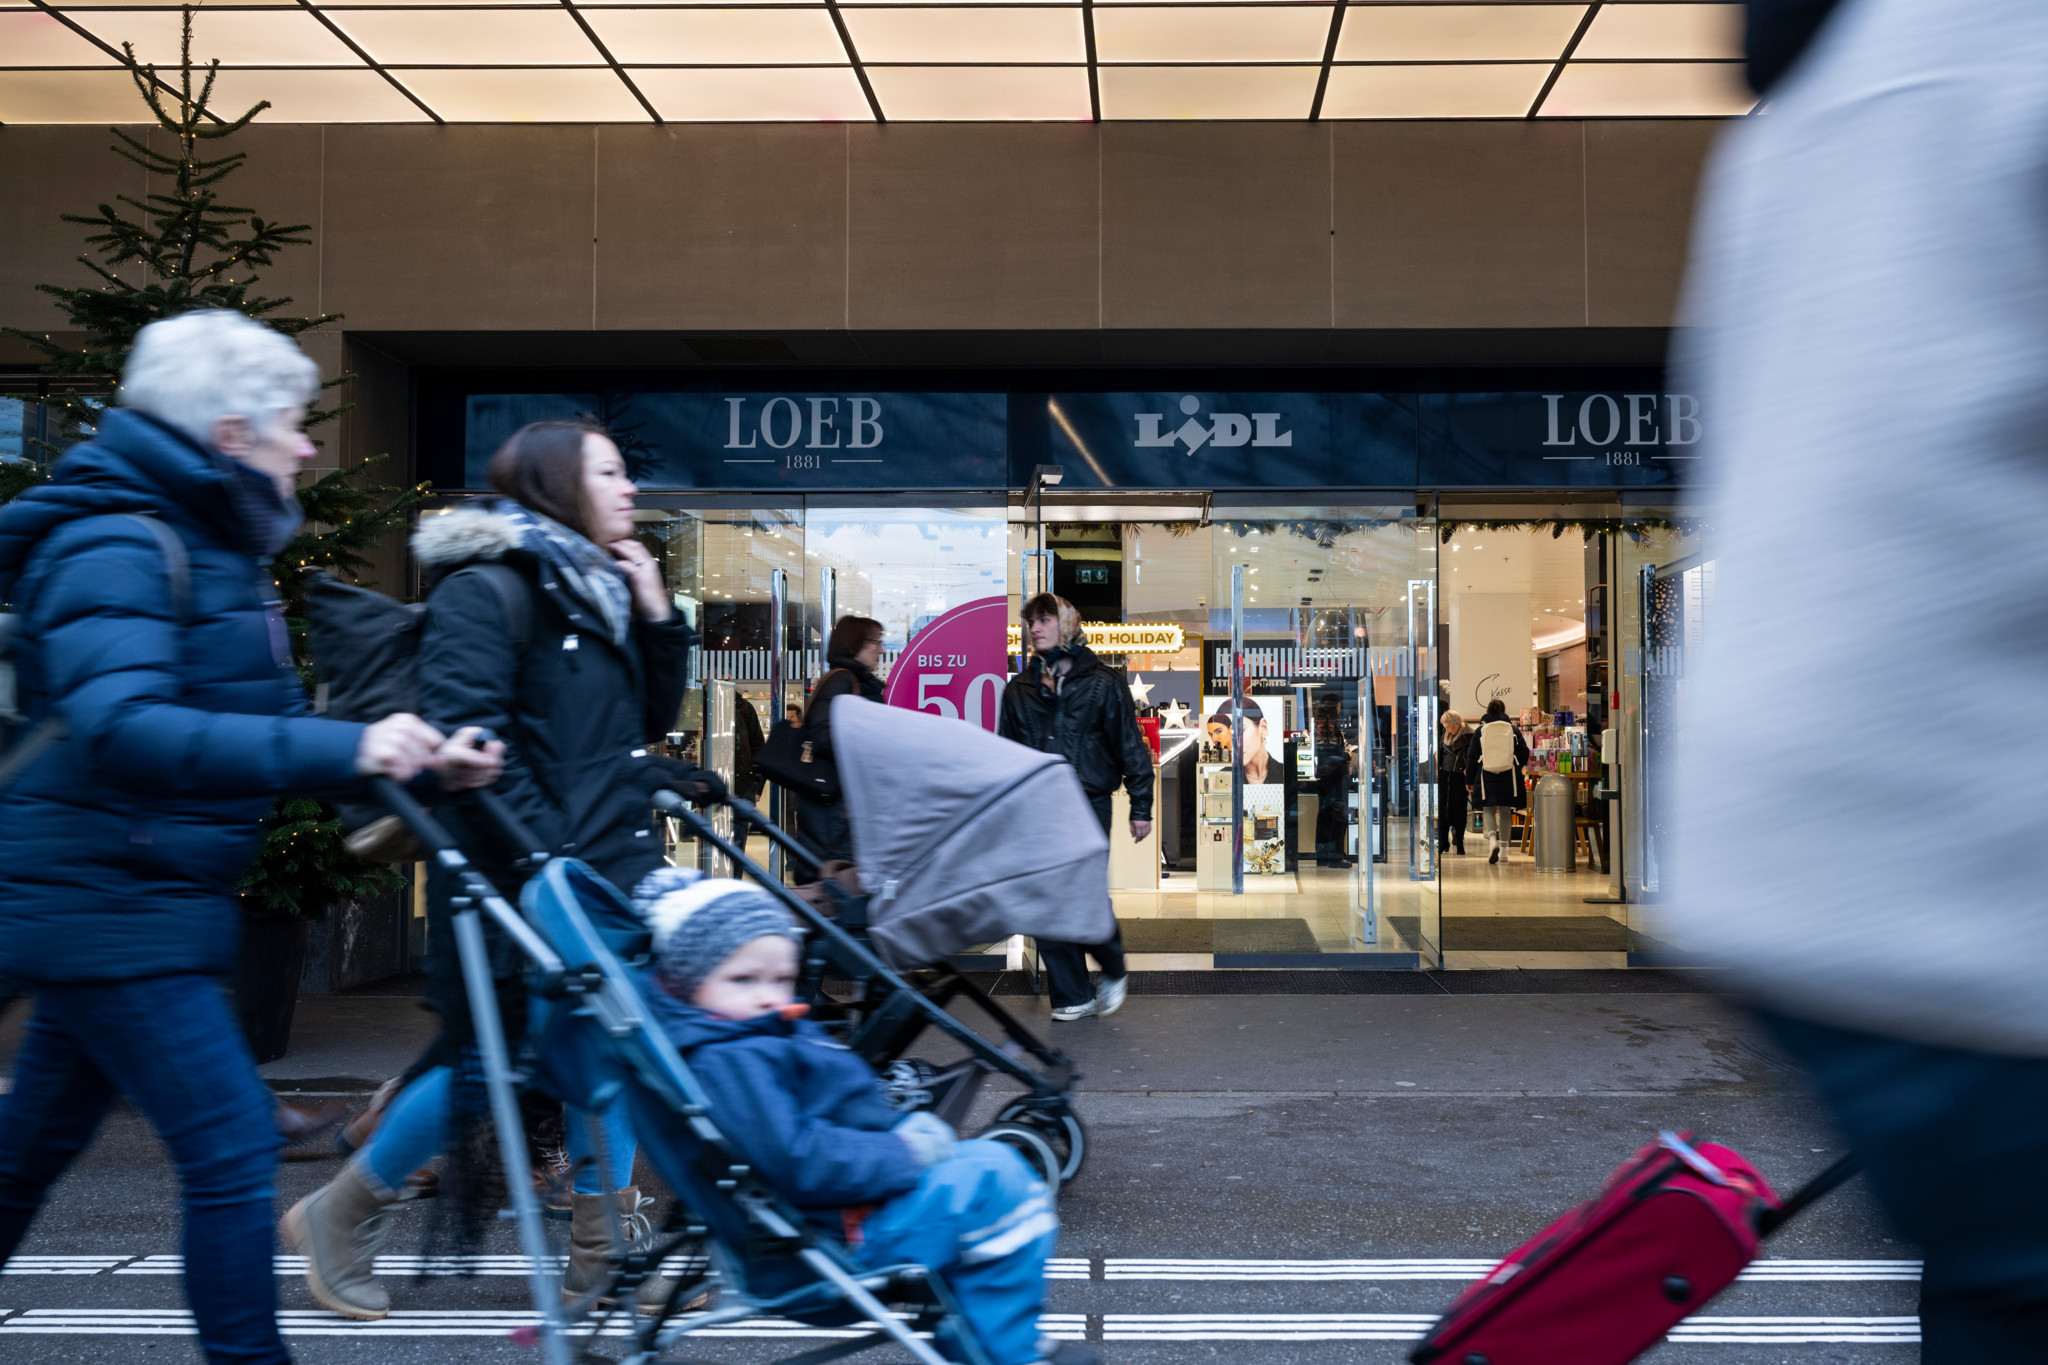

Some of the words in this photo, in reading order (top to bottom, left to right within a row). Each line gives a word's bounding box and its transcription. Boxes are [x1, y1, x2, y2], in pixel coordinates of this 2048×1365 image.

[723, 397, 884, 449] LOEB
[1542, 394, 1703, 446] LOEB
[786, 455, 821, 469] 1881
[1605, 452, 1641, 466] 1881
[1109, 632, 1175, 645] HOLIDAY
[918, 654, 943, 667] BIS
[947, 654, 967, 667] ZU
[1491, 686, 1512, 700] Kasse
[917, 673, 1007, 735] 50
